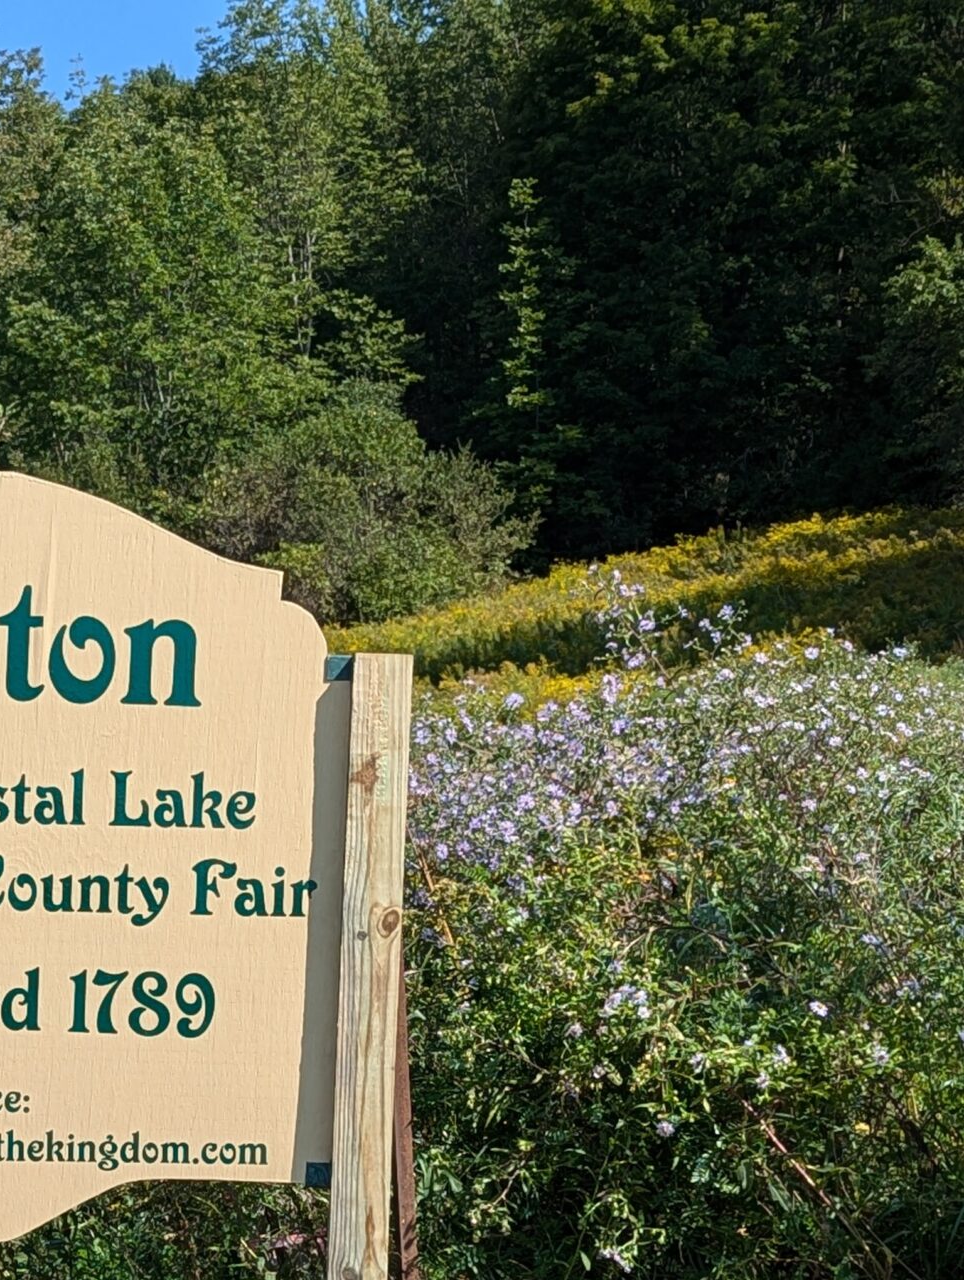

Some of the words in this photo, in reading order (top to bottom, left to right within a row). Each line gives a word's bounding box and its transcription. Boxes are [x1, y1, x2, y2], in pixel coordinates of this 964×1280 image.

[109, 771, 255, 829] Lake
[190, 858, 318, 917] Fair
[68, 970, 215, 1038] 1789
